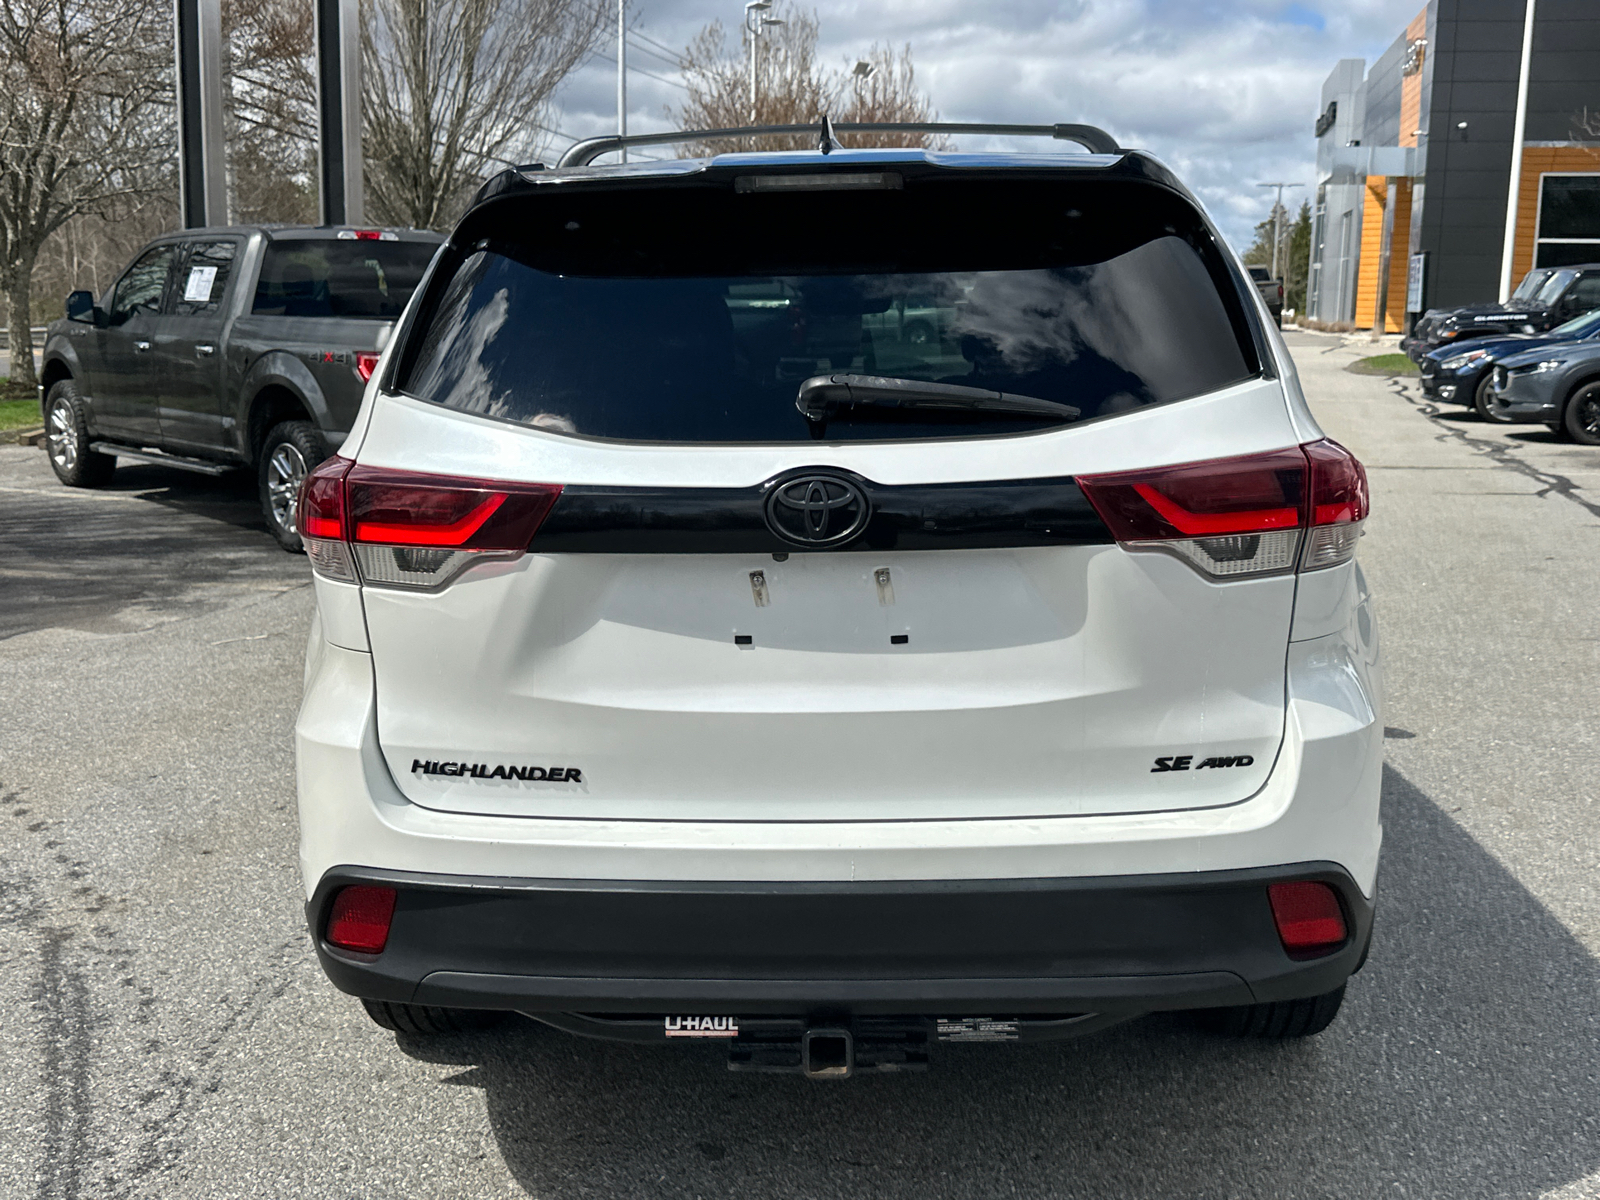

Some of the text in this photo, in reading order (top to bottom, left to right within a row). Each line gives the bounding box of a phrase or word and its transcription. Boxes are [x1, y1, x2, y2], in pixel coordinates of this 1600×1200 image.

[410, 758, 582, 783] HIGHLANDER
[1150, 755, 1254, 773] SE AWD
[665, 1016, 739, 1030] U-HAUL
